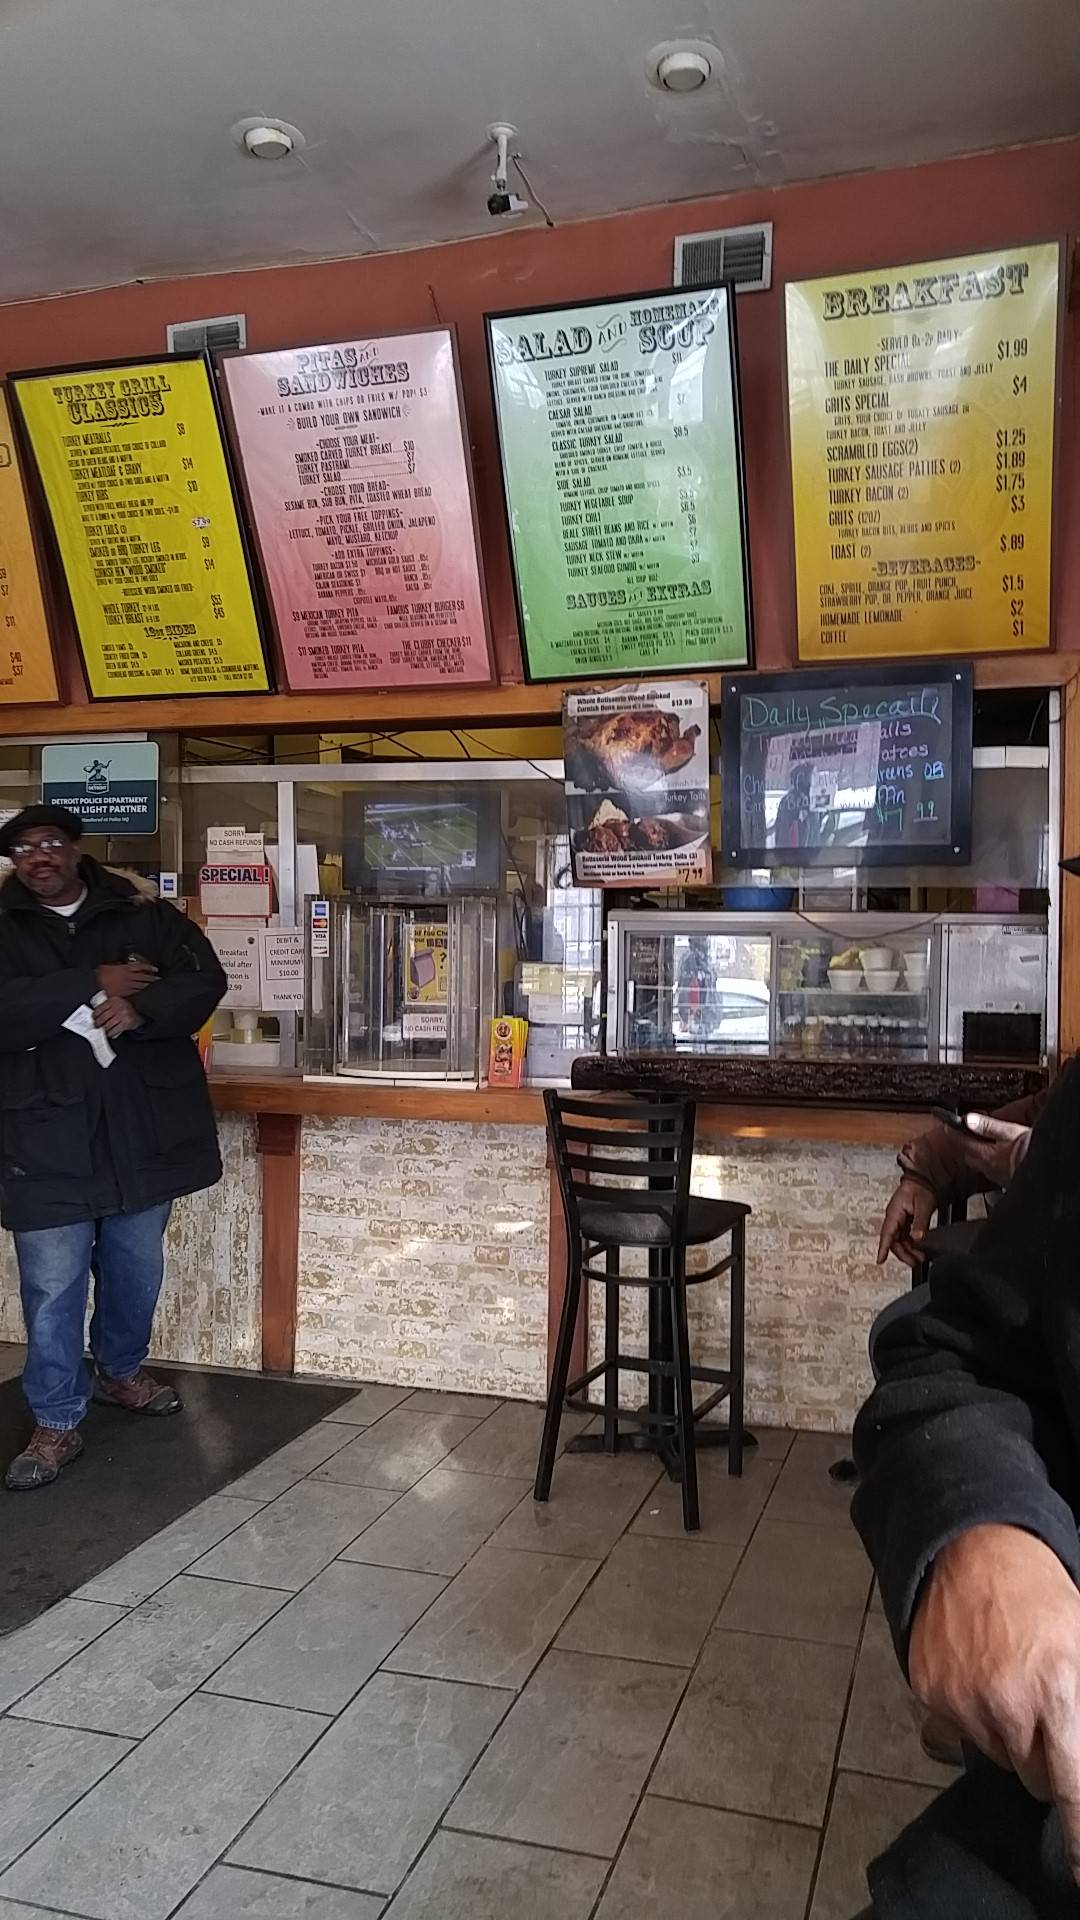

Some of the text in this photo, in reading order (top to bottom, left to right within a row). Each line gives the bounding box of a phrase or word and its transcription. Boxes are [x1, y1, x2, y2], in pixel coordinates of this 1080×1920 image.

[822, 263, 1029, 320] BREAKFAST
[630, 297, 719, 327] HOMEMADE
[640, 318, 714, 354] SOUP
[496, 326, 593, 366] SALAD
[997, 338, 1028, 361] $1.99
[296, 347, 358, 374] PITAS
[824, 352, 911, 378] THE DAILY SPECIAL
[277, 362, 410, 397] SANDWICHES
[544, 361, 619, 381] TURKEY SUPREME SALAD
[834, 362, 994, 391] TURKEY JELLY
[53, 375, 171, 404] TURKEY GRILL
[1013, 375, 1027, 398] $4
[66, 391, 165, 424] CLASSICS
[573, 405, 593, 418] SALAD
[825, 391, 890, 415] GRITS SPECIAL
[933, 404, 959, 418] SAUSAGE
[297, 406, 401, 430] BUILD YOUR OWN SANDWICH
[62, 432, 112, 447] TURKEY MEATBALLS
[342, 435, 358, 447] YOUR
[552, 432, 623, 452] CLASSIC TURKEY SALAD
[996, 428, 1026, 449] $1.25
[295, 442, 392, 464] SMOKED CARVED TURKEY BREAST
[826, 437, 919, 462] SCRAMBLED EGGS(2)
[297, 460, 351, 475] TURKEY PASTRAMI
[828, 458, 962, 485] TURKEY SAUSAGE PATTIES (2)
[299, 472, 342, 486] TURKEY SALAD
[557, 479, 571, 491] SIDE
[572, 477, 591, 489] SALAD
[996, 472, 1025, 493] $1.75
[349, 483, 365, 494] YOUR
[367, 486, 432, 503] TOASTED WHEAT BREAD
[828, 485, 910, 505] TURKEY BACON (2)
[560, 494, 634, 513] TURKEY VEGETABLE SOUP
[1011, 494, 1025, 513] $3
[336, 511, 368, 523] YOUR FREE
[561, 515, 583, 527] TURKEY
[829, 508, 854, 527] GRITS
[375, 531, 398, 542] KETCHUP
[581, 519, 651, 538] STREET BEANS RICE
[129, 541, 161, 554] TURKEY LEG
[347, 548, 365, 559] EXTRA
[564, 537, 614, 553] SAUSAGE TOMATO
[831, 543, 856, 560] TOAST
[566, 549, 622, 566] TURKEY NECK STEW
[567, 566, 589, 579] TURKEY
[868, 578, 931, 594] ORANGE FRUIT
[1002, 574, 1024, 593] $1.5
[566, 579, 712, 610] SAUCES EXTRAS
[820, 587, 972, 608] STRAWBERRY ORANGE JUICE
[325, 607, 360, 620] TURKEY PITA
[387, 602, 432, 616] FAMOUS TURKEY
[1011, 599, 1024, 616] $2
[820, 609, 902, 626] HOMEMADE LEMONADE
[1012, 618, 1024, 637] $1
[820, 631, 847, 644] COFFEE
[331, 643, 351, 654] TURKEY
[746, 697, 811, 731] Daily
[51, 796, 148, 805] DETROIT POLICE DEPARTMENT
[664, 791, 706, 804] Turkey Tails
[82, 804, 148, 814] LIGHT PARTNER
[236, 838, 263, 846] REFUNDS
[653, 853, 673, 862] Turkey
[201, 867, 261, 882] SPECIAL
[219, 949, 248, 957] Breakfast
[269, 948, 289, 956] CREDIT
[237, 960, 252, 968] after
[270, 959, 301, 967] MINIMUM
[279, 969, 299, 977] $10.00
[273, 993, 292, 1001] THANK
[414, 1025, 431, 1033] CASH
